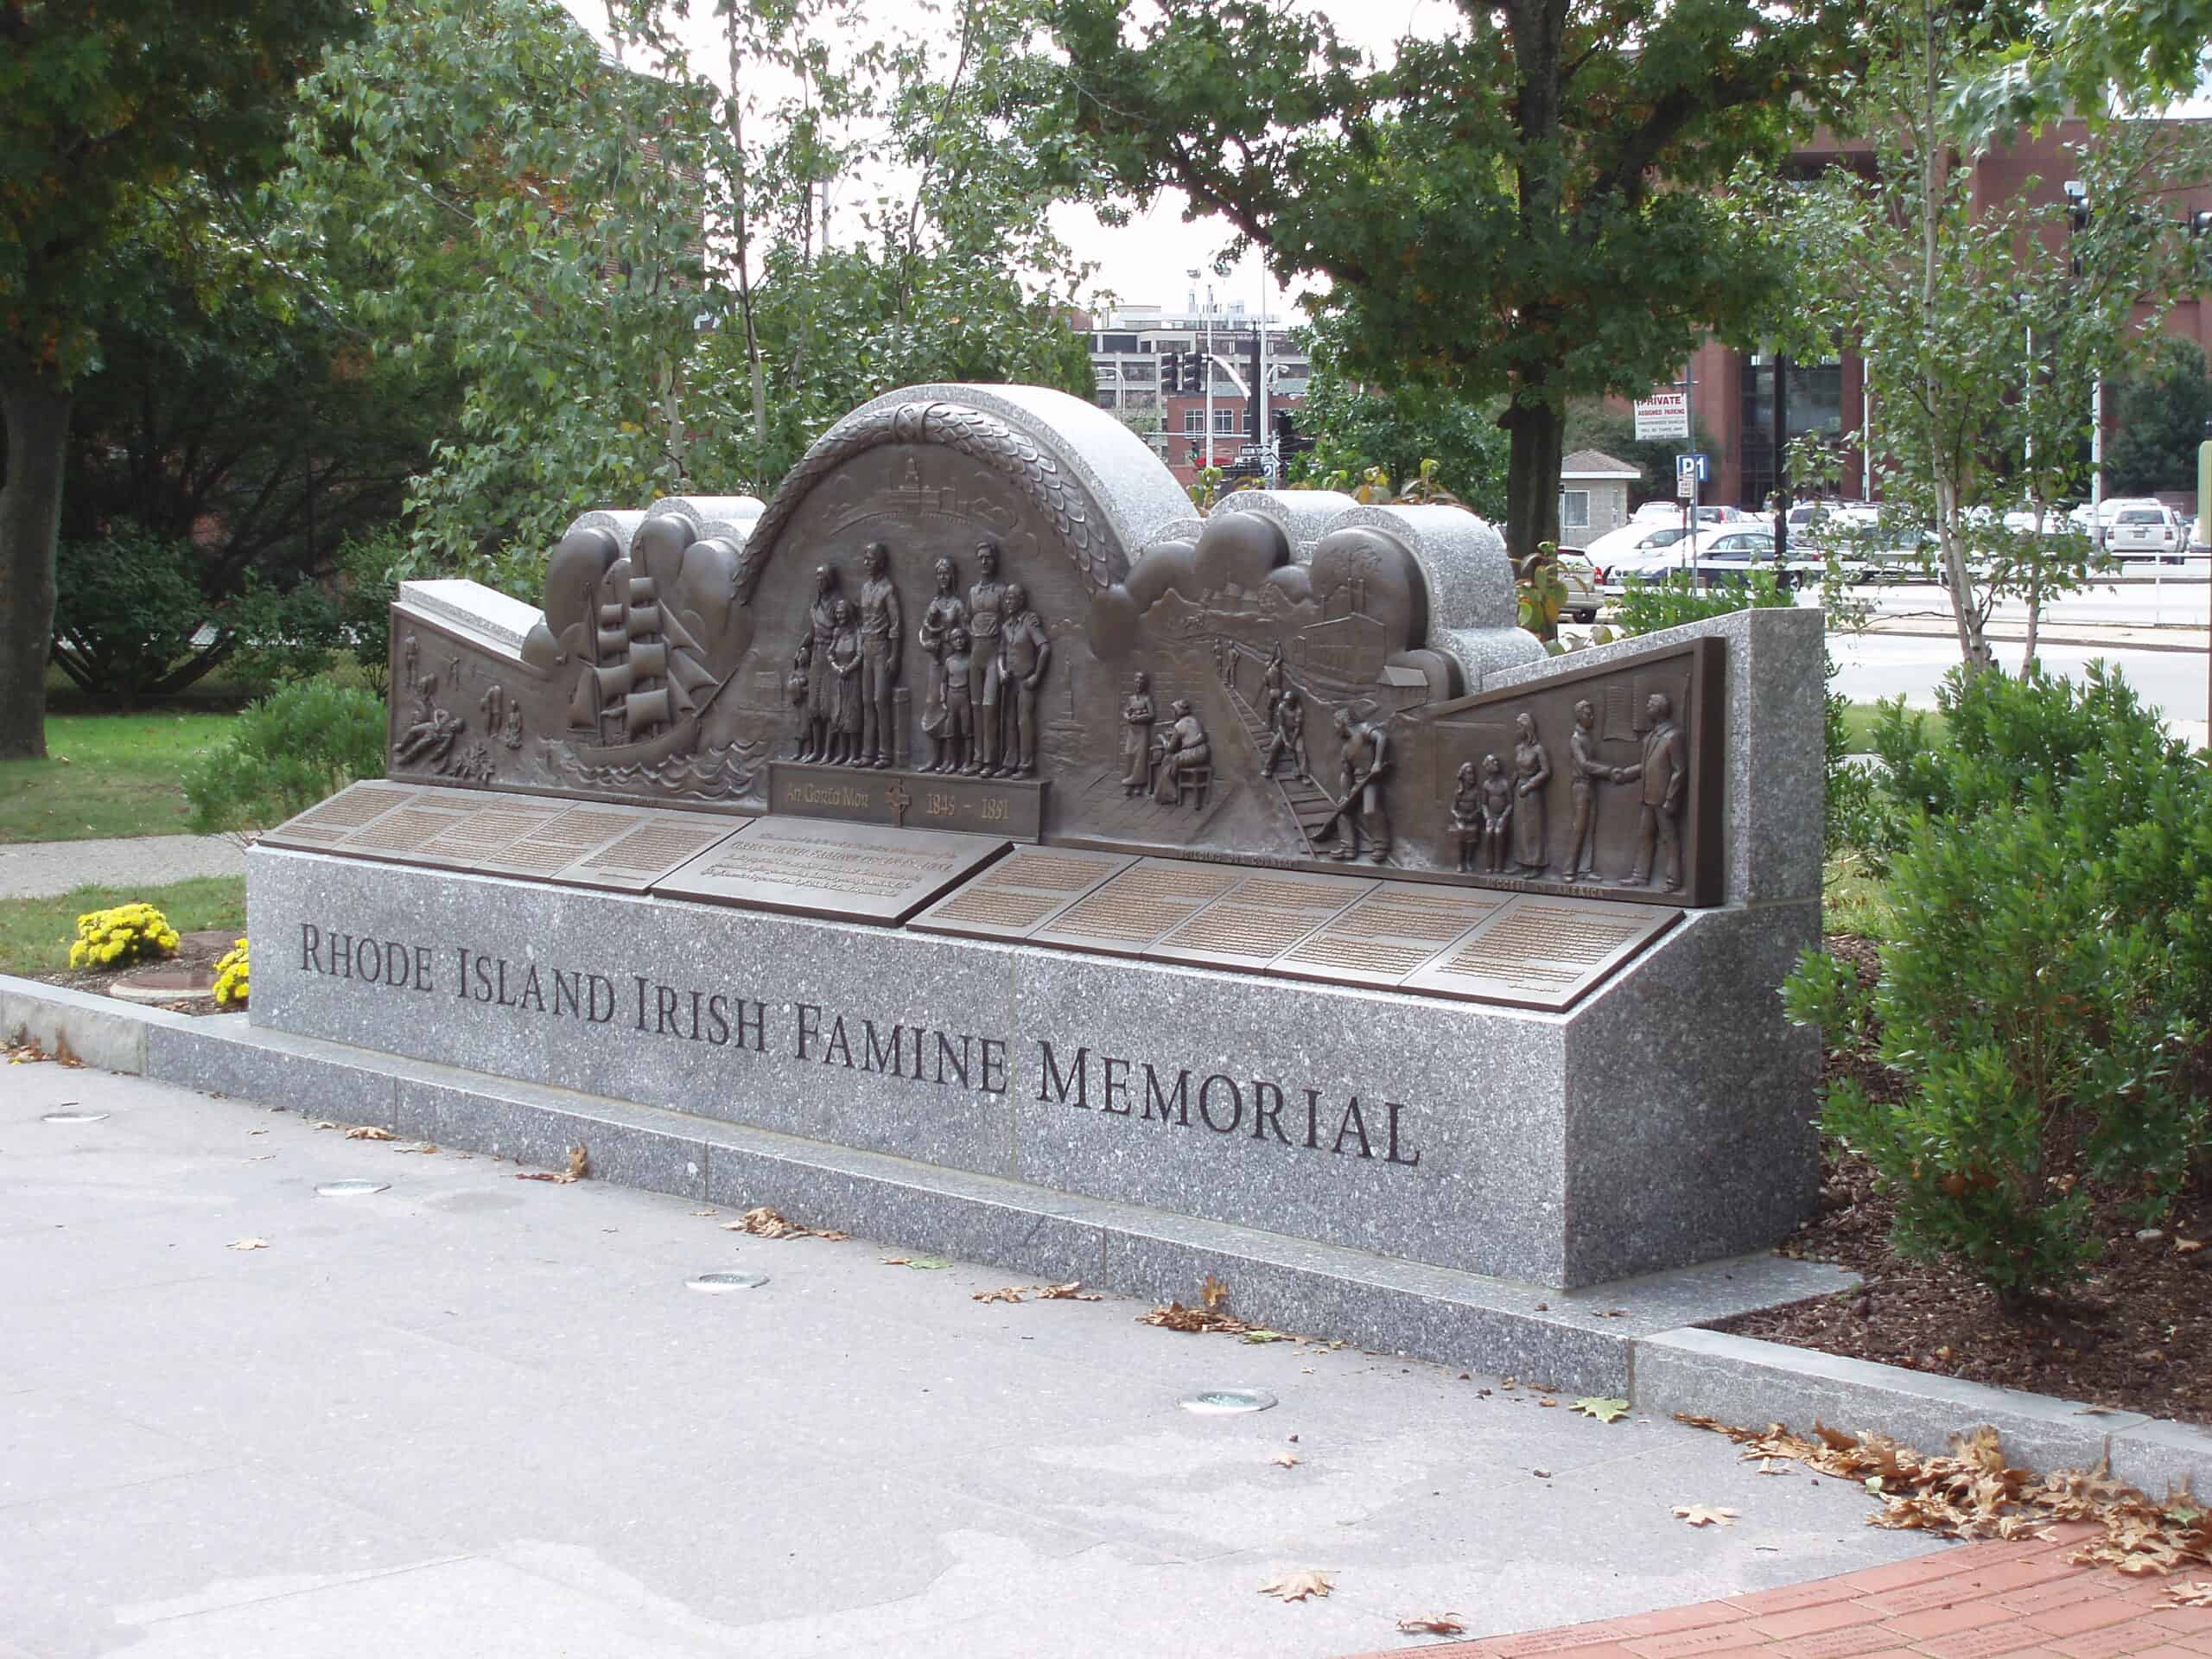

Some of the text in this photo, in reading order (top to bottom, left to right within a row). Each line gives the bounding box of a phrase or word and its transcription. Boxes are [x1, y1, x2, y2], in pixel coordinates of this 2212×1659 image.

[1641, 396, 1681, 406] PRIVATE
[925, 792, 955, 816] 1845
[981, 798, 1009, 819] 1851
[1558, 884, 1605, 898] AMERICA
[300, 923, 1421, 1167] RHODE ISLAND IRISH FAMINE MEMORIAL
